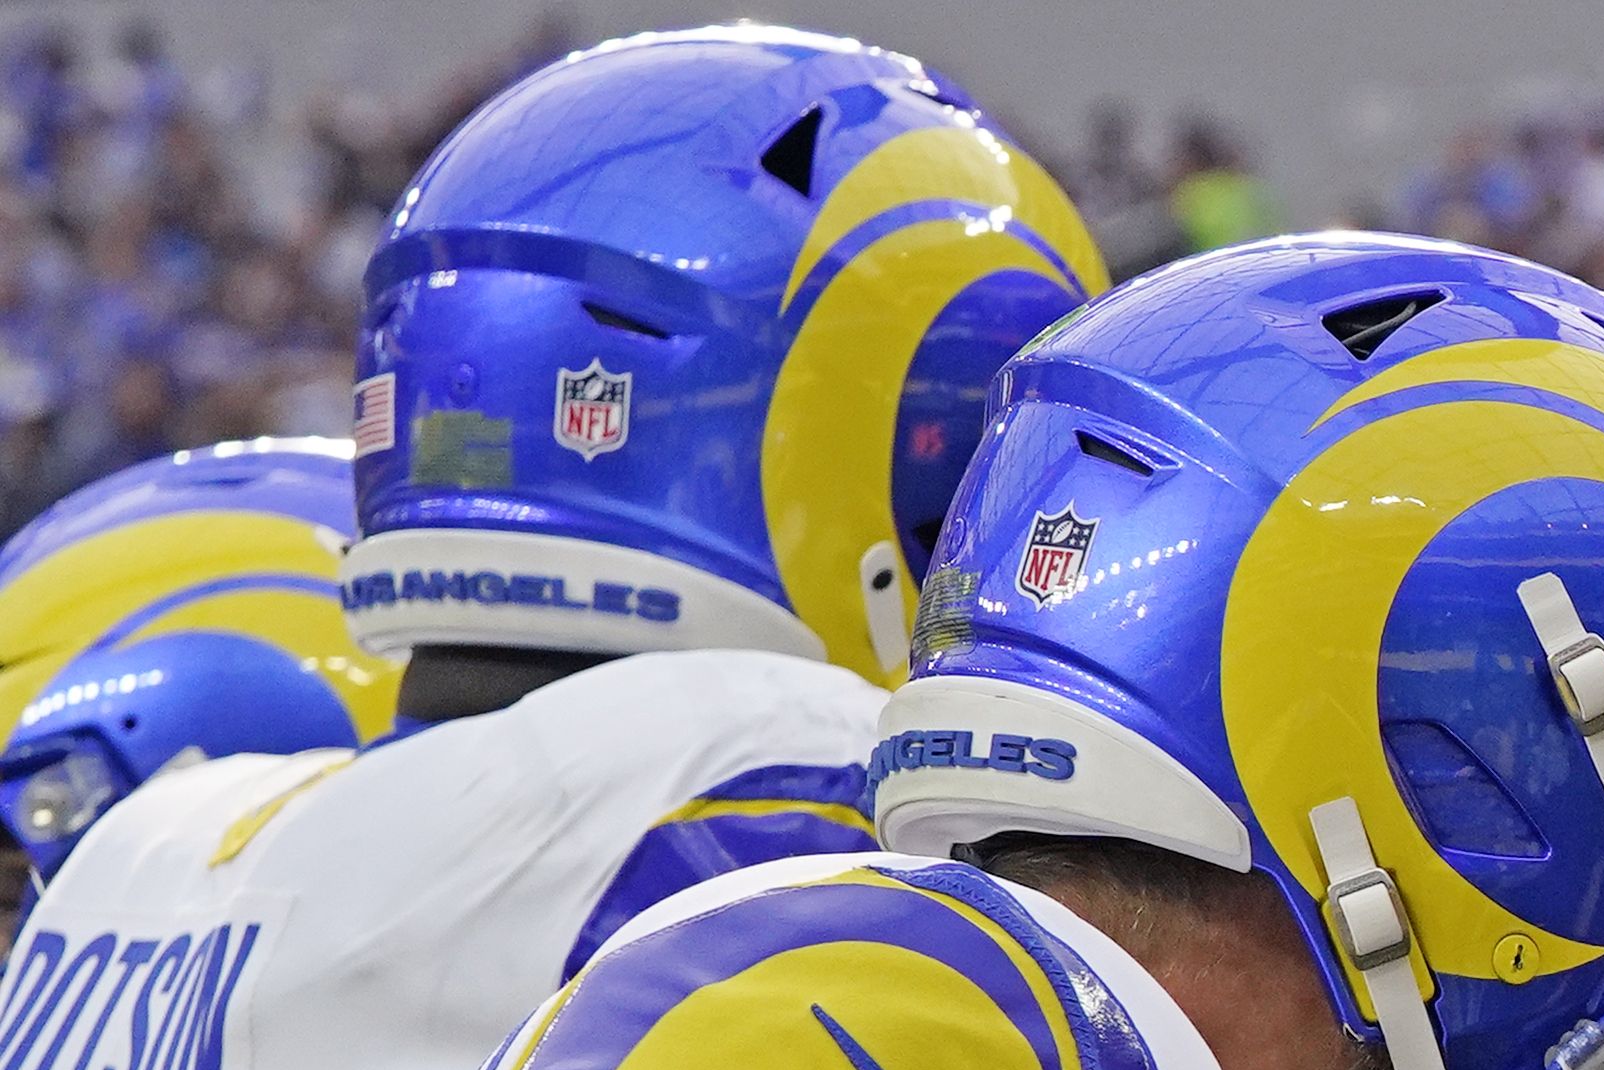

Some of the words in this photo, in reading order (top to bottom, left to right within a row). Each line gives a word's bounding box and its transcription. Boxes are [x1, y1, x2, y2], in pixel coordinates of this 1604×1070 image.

[567, 402, 619, 441] NFL
[1025, 548, 1074, 591] NFL
[867, 730, 1077, 782] NGELES
